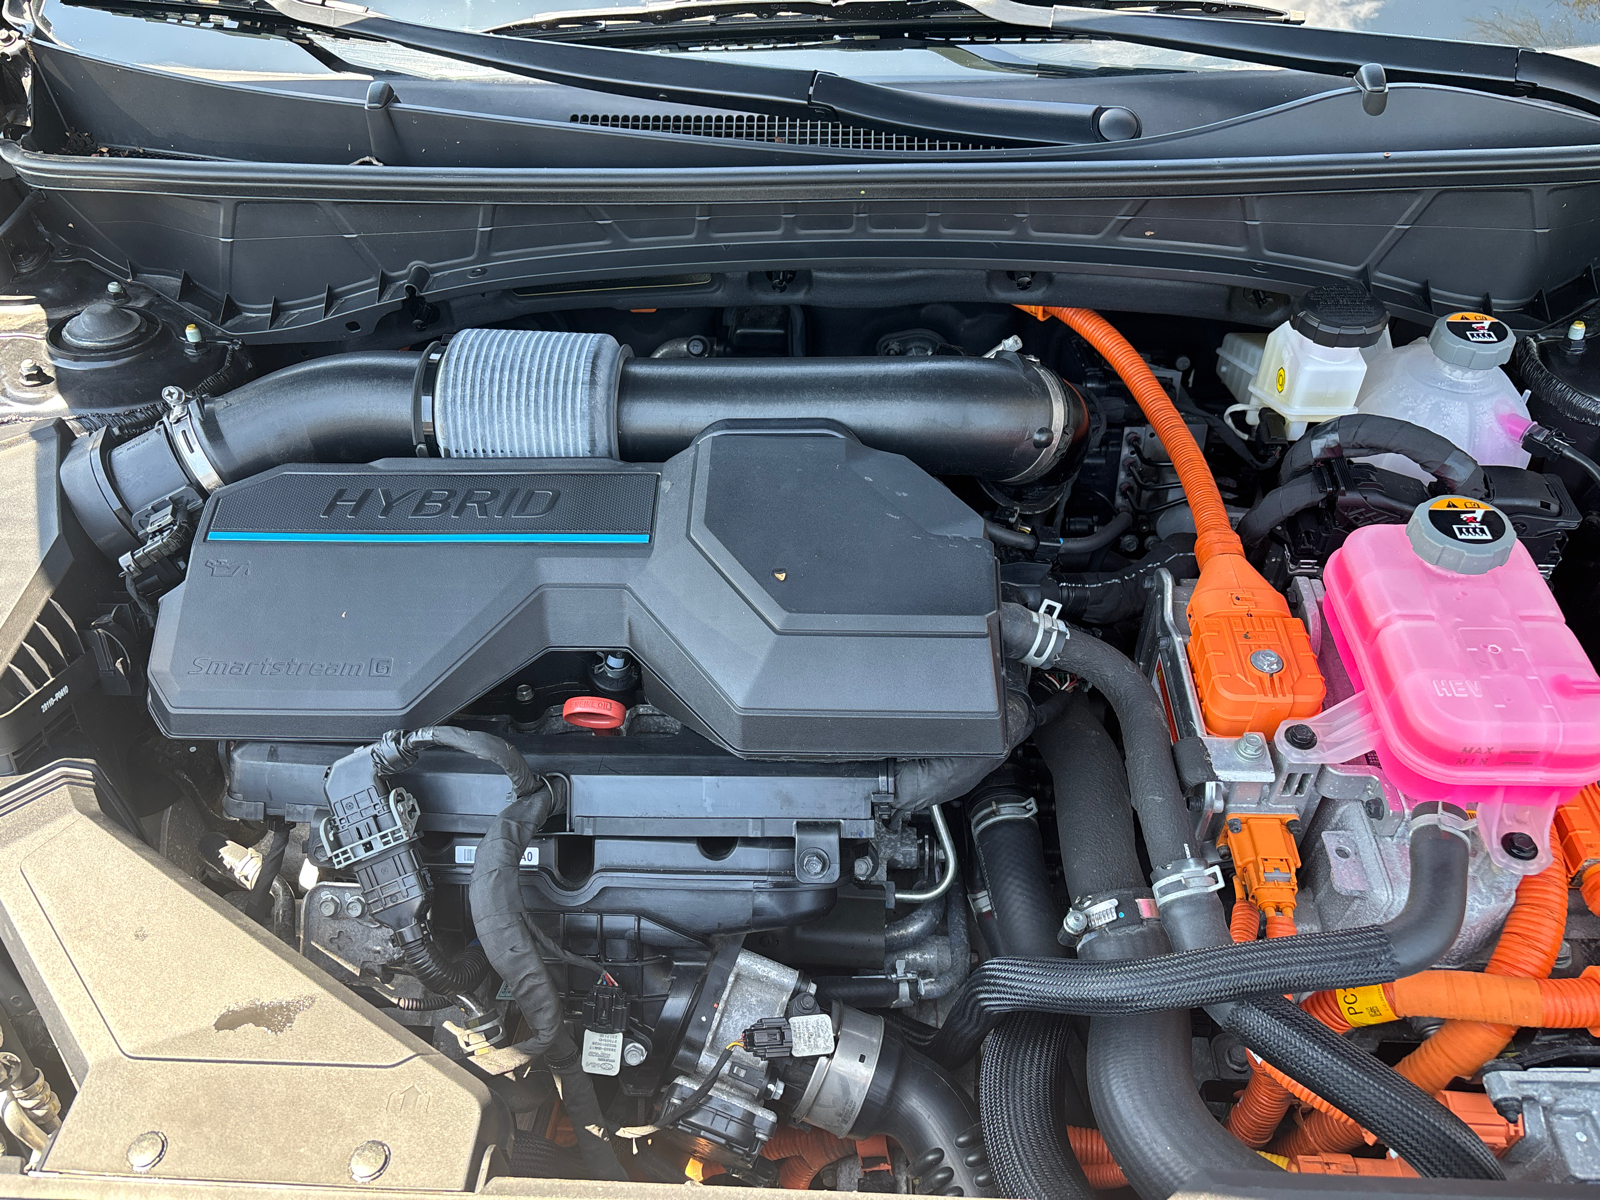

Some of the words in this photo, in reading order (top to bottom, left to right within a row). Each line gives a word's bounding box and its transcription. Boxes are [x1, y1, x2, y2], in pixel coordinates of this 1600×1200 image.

[319, 487, 561, 519] HYBRID
[187, 656, 365, 677] Smartstream
[1432, 680, 1483, 697] HEV
[570, 700, 597, 709] ENGINE
[597, 701, 611, 710] OIL
[1461, 746, 1494, 755] MAX
[1456, 758, 1488, 766] MIN
